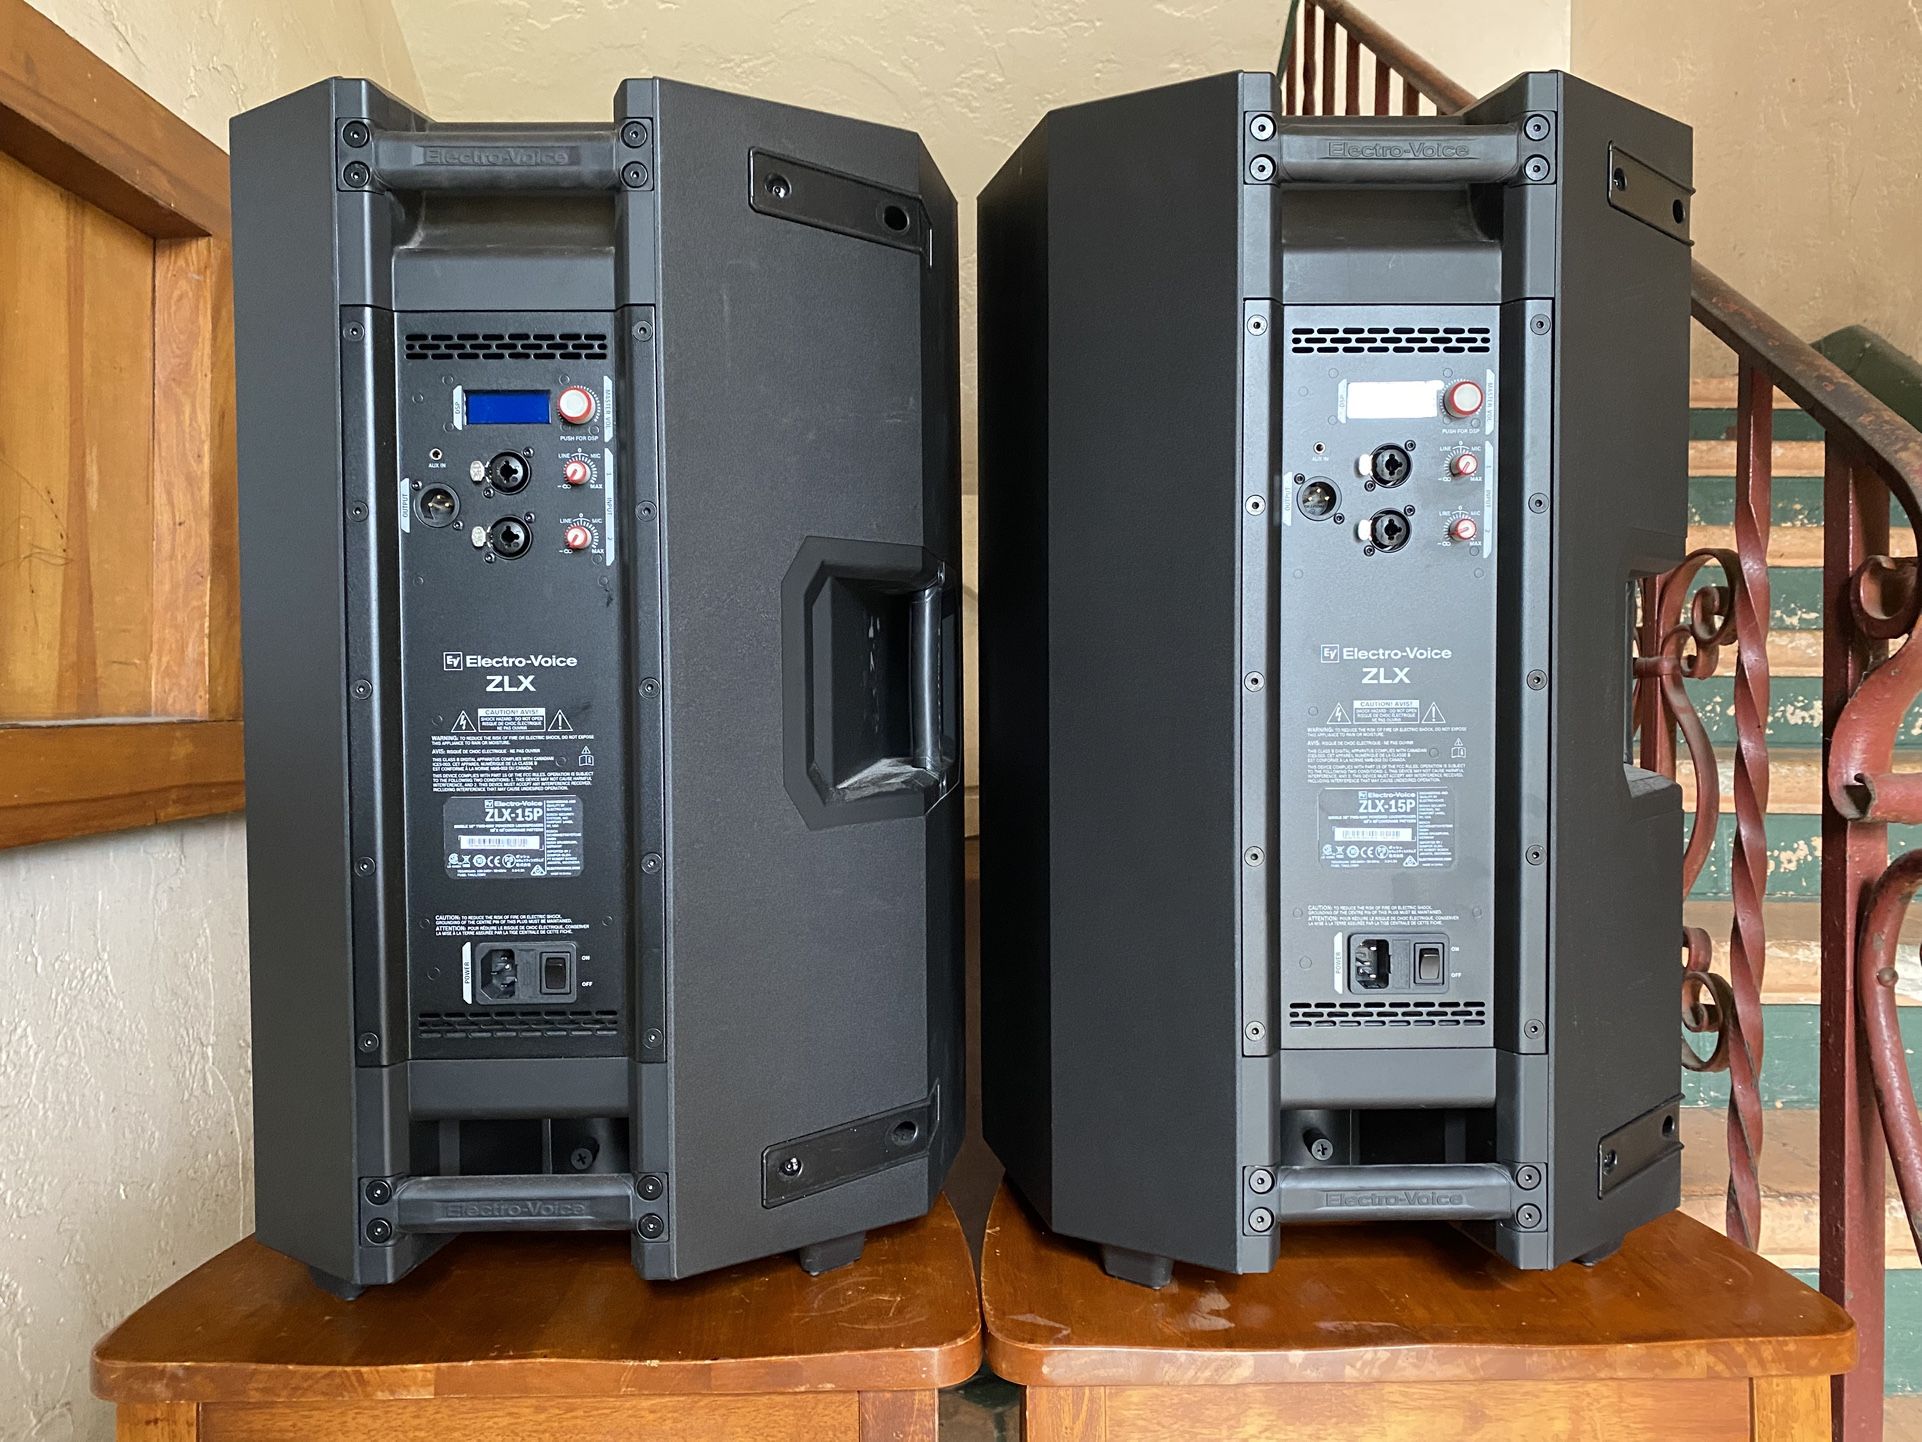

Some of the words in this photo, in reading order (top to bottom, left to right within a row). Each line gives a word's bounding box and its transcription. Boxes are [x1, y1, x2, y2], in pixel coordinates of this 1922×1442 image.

[426, 148, 568, 165] Electro-Voice
[1328, 140, 1469, 158] Electro-Voice
[466, 654, 578, 668] Electro-Voice
[1342, 647, 1452, 660] Electro-Voice
[486, 675, 536, 692] ZLX
[1361, 668, 1411, 684] ZLX
[1358, 799, 1415, 812] ZLX-15P
[485, 808, 543, 821] ZLX-15P
[1326, 1192, 1463, 1207] Electro-Voice
[449, 1202, 585, 1217] Electro-Voice
